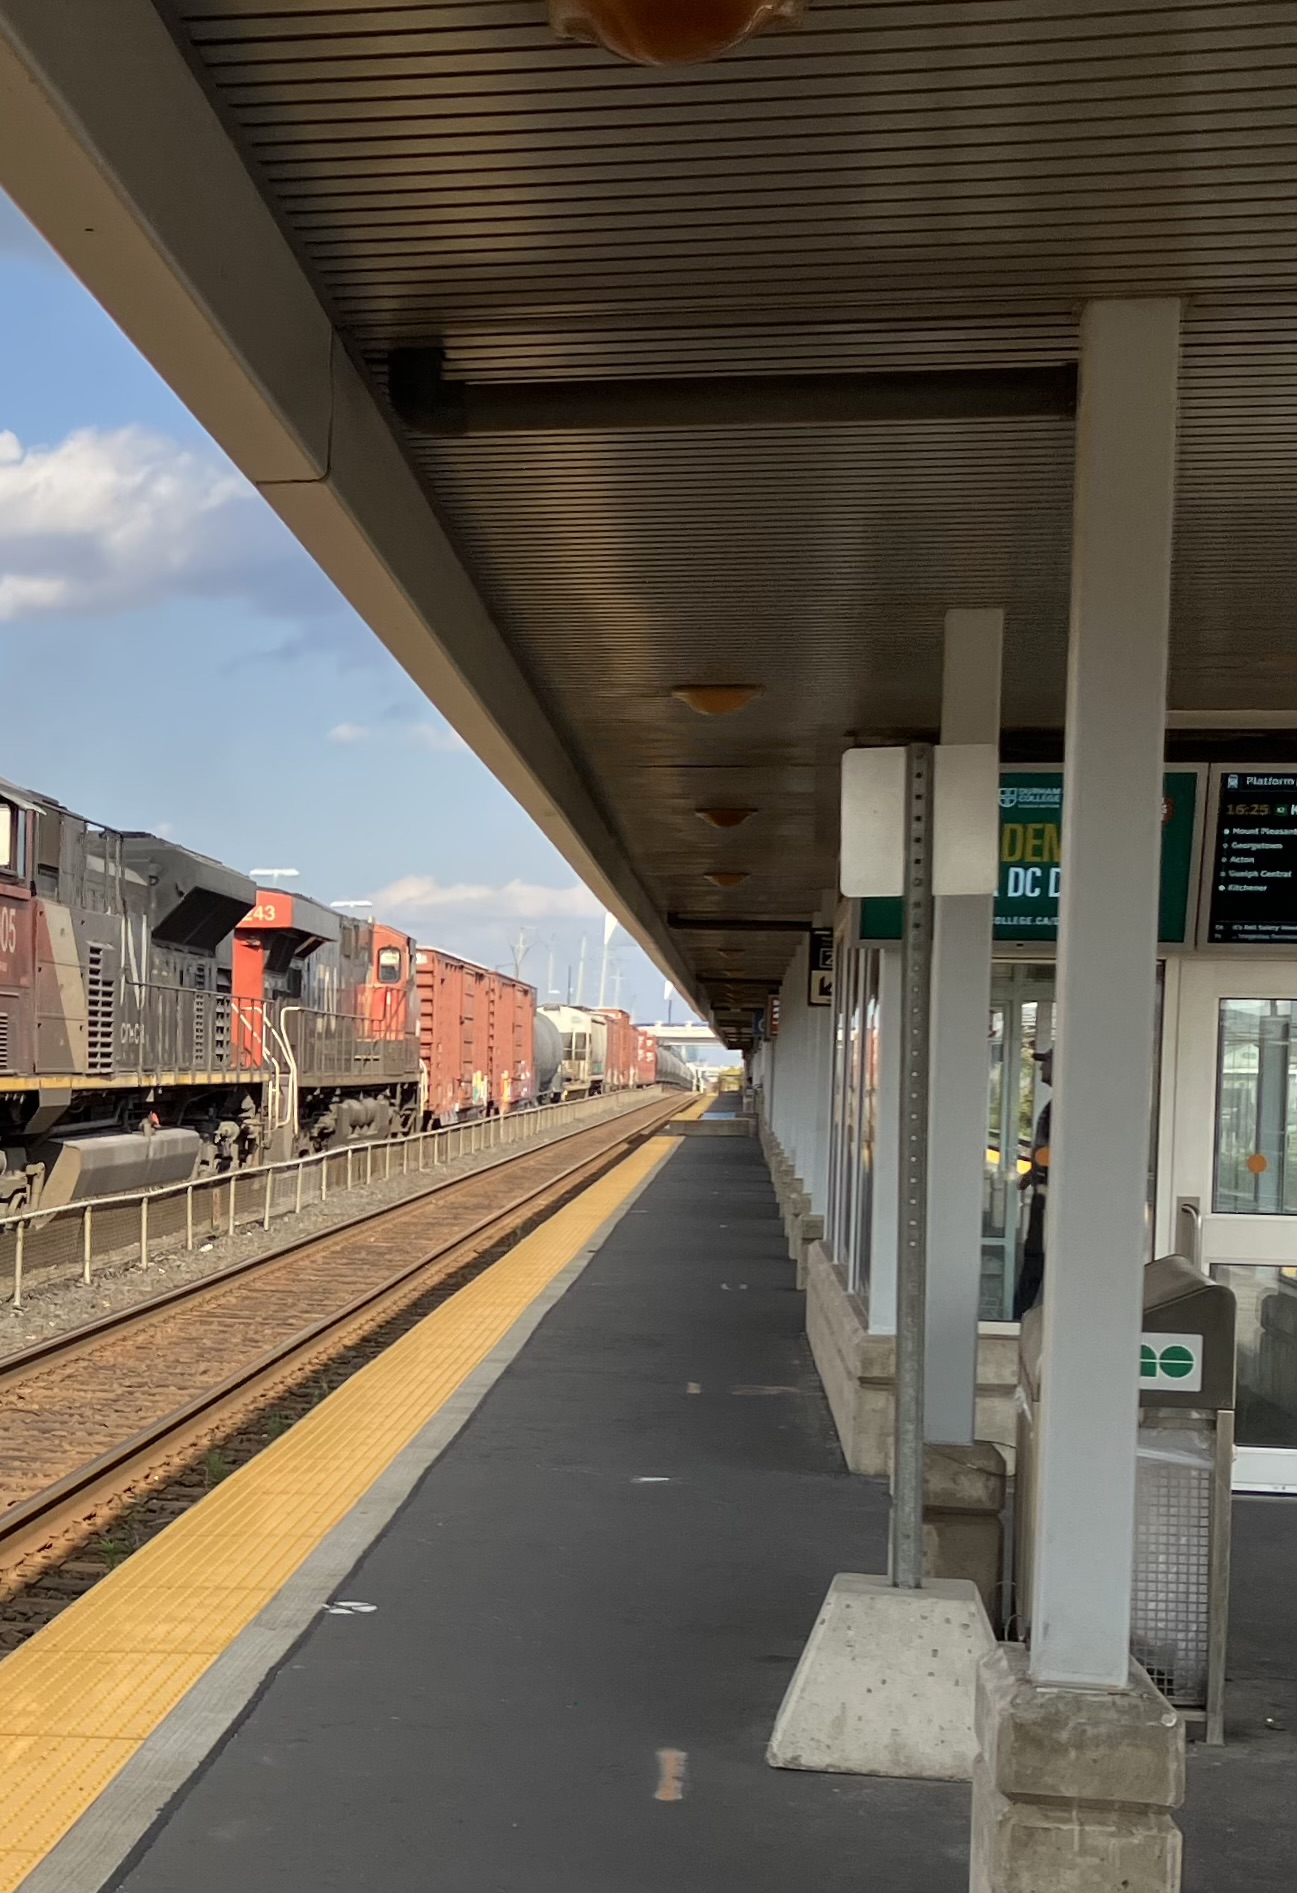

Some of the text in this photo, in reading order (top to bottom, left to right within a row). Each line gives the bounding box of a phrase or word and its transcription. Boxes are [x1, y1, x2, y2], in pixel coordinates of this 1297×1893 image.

[1246, 776, 1295, 785] Platform
[1007, 867, 1042, 897] DC
[992, 916, 1061, 925] OLLEGE.CA/
